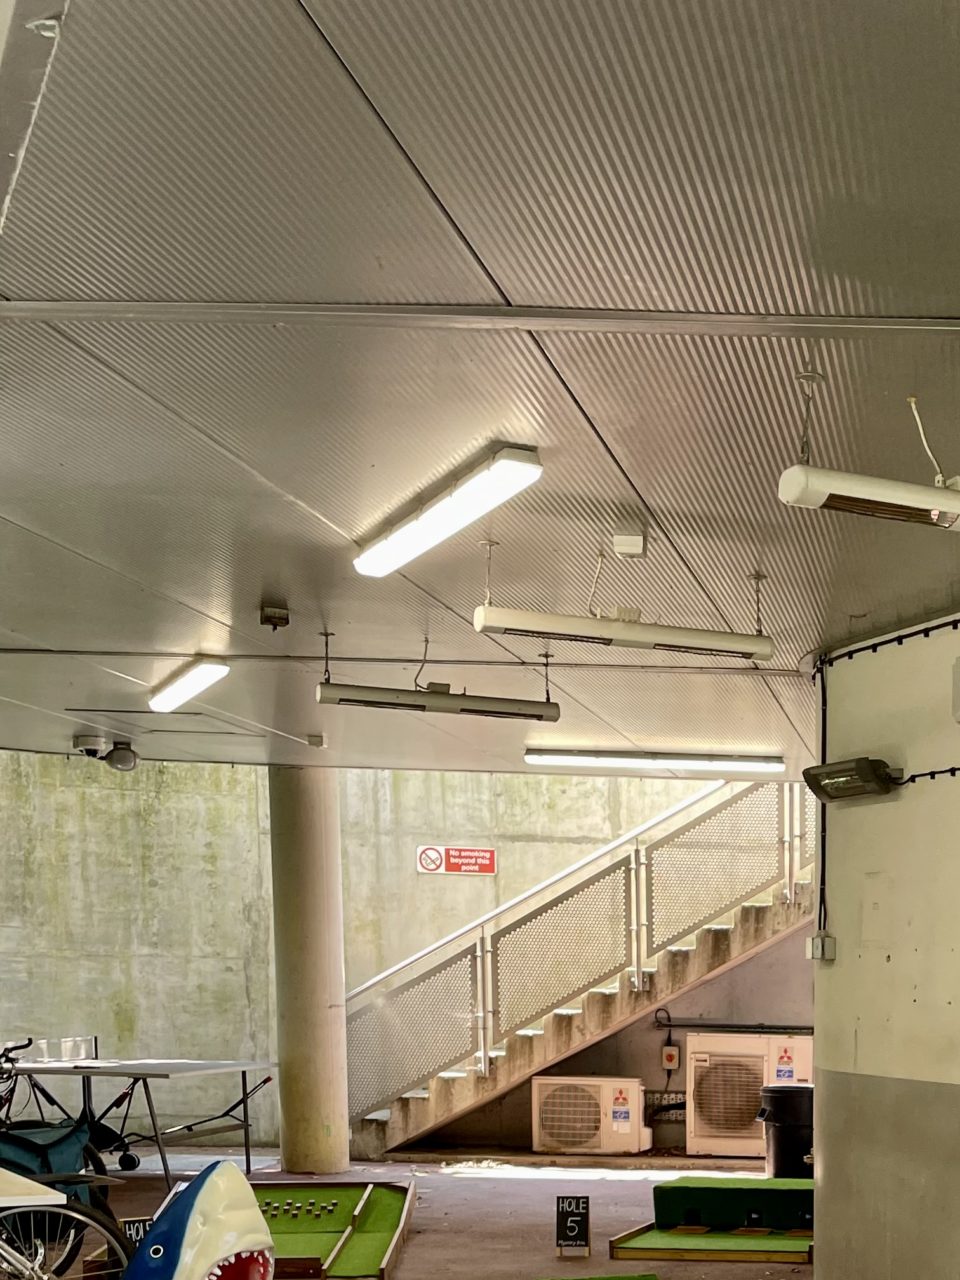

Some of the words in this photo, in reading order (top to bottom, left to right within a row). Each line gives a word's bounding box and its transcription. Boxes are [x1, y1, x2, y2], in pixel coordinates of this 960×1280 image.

[461, 851, 491, 859] smoking
[450, 857, 476, 865] beyond
[477, 857, 490, 865] this
[559, 1198, 587, 1213] HOLE
[566, 1217, 581, 1236] 5
